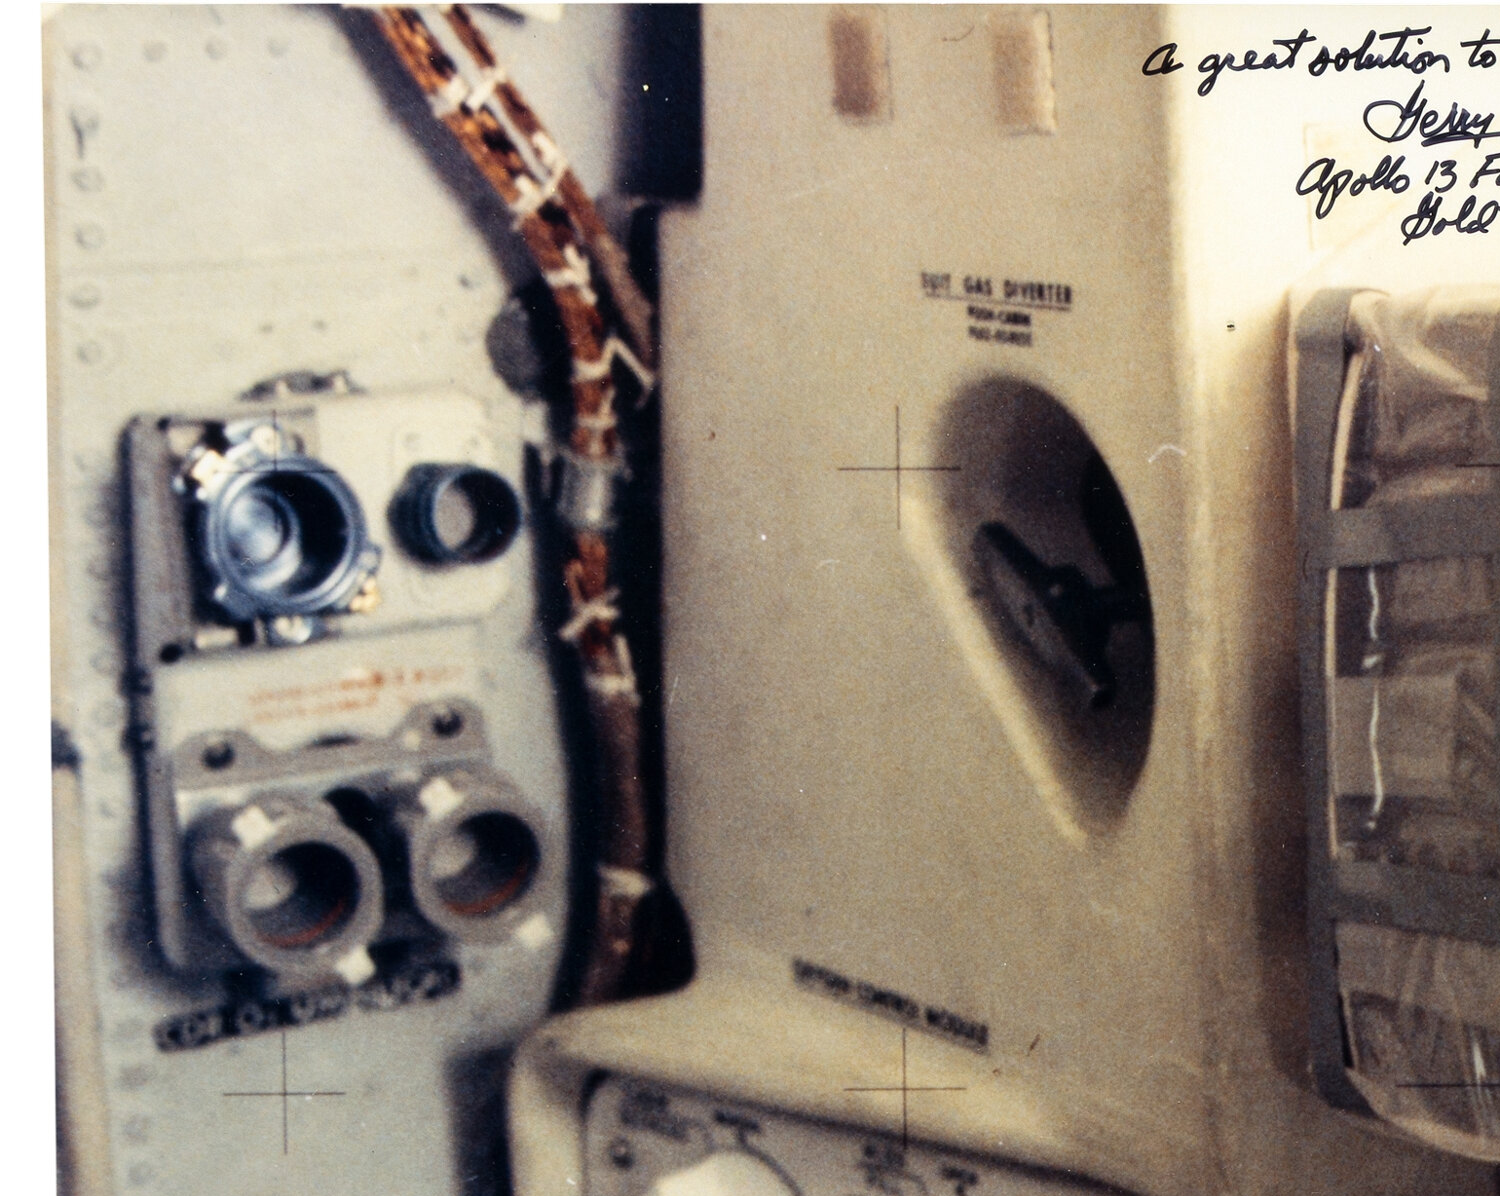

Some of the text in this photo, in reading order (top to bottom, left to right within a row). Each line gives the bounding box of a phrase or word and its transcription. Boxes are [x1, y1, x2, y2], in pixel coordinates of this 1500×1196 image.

[1197, 28, 1317, 97] great
[1308, 26, 1450, 77] solution
[1424, 159, 1458, 193] 13
[963, 275, 992, 297] GAS
[1003, 278, 1072, 304] DIVERTER
